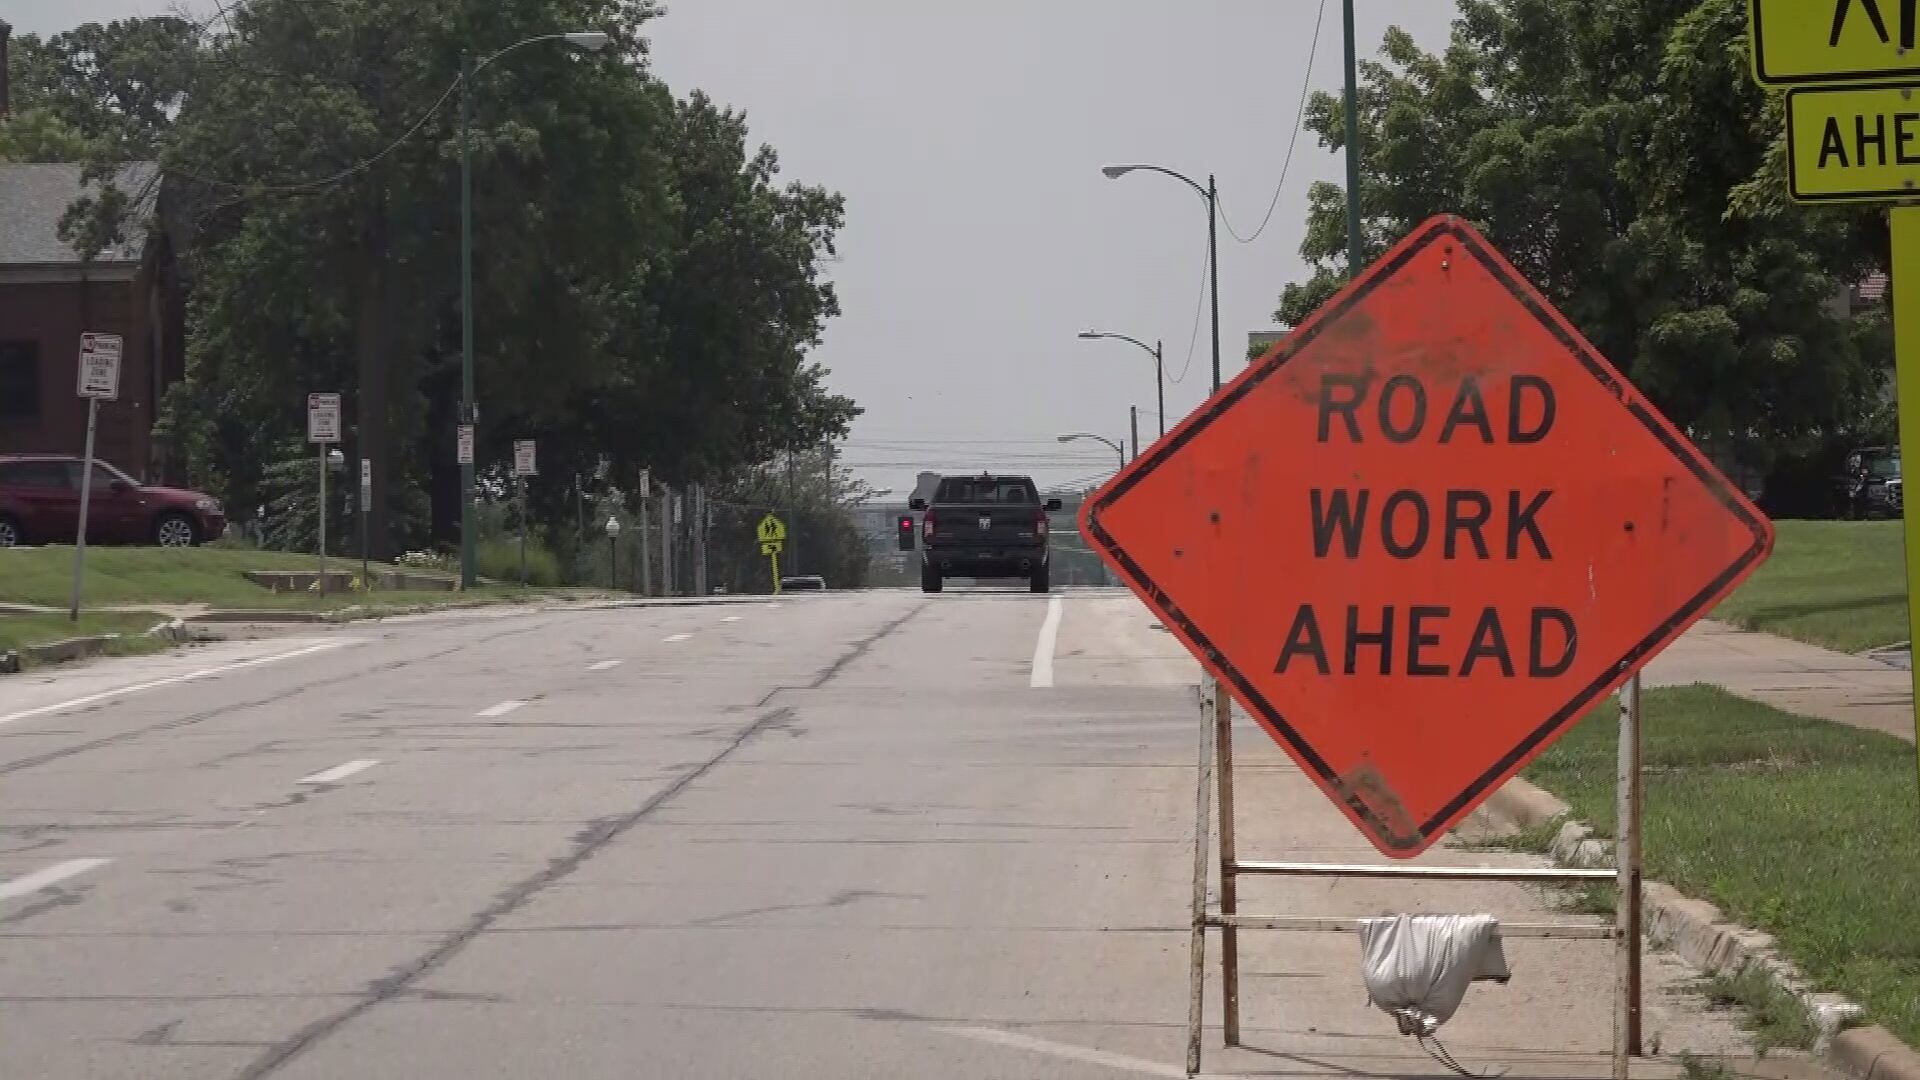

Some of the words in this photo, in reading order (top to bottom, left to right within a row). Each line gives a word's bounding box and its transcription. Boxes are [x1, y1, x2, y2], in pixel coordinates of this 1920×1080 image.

[1817, 112, 1920, 169] AHE
[1317, 374, 1556, 443] ROAD
[1309, 488, 1554, 560] WORK
[1273, 604, 1578, 677] AHEAD
